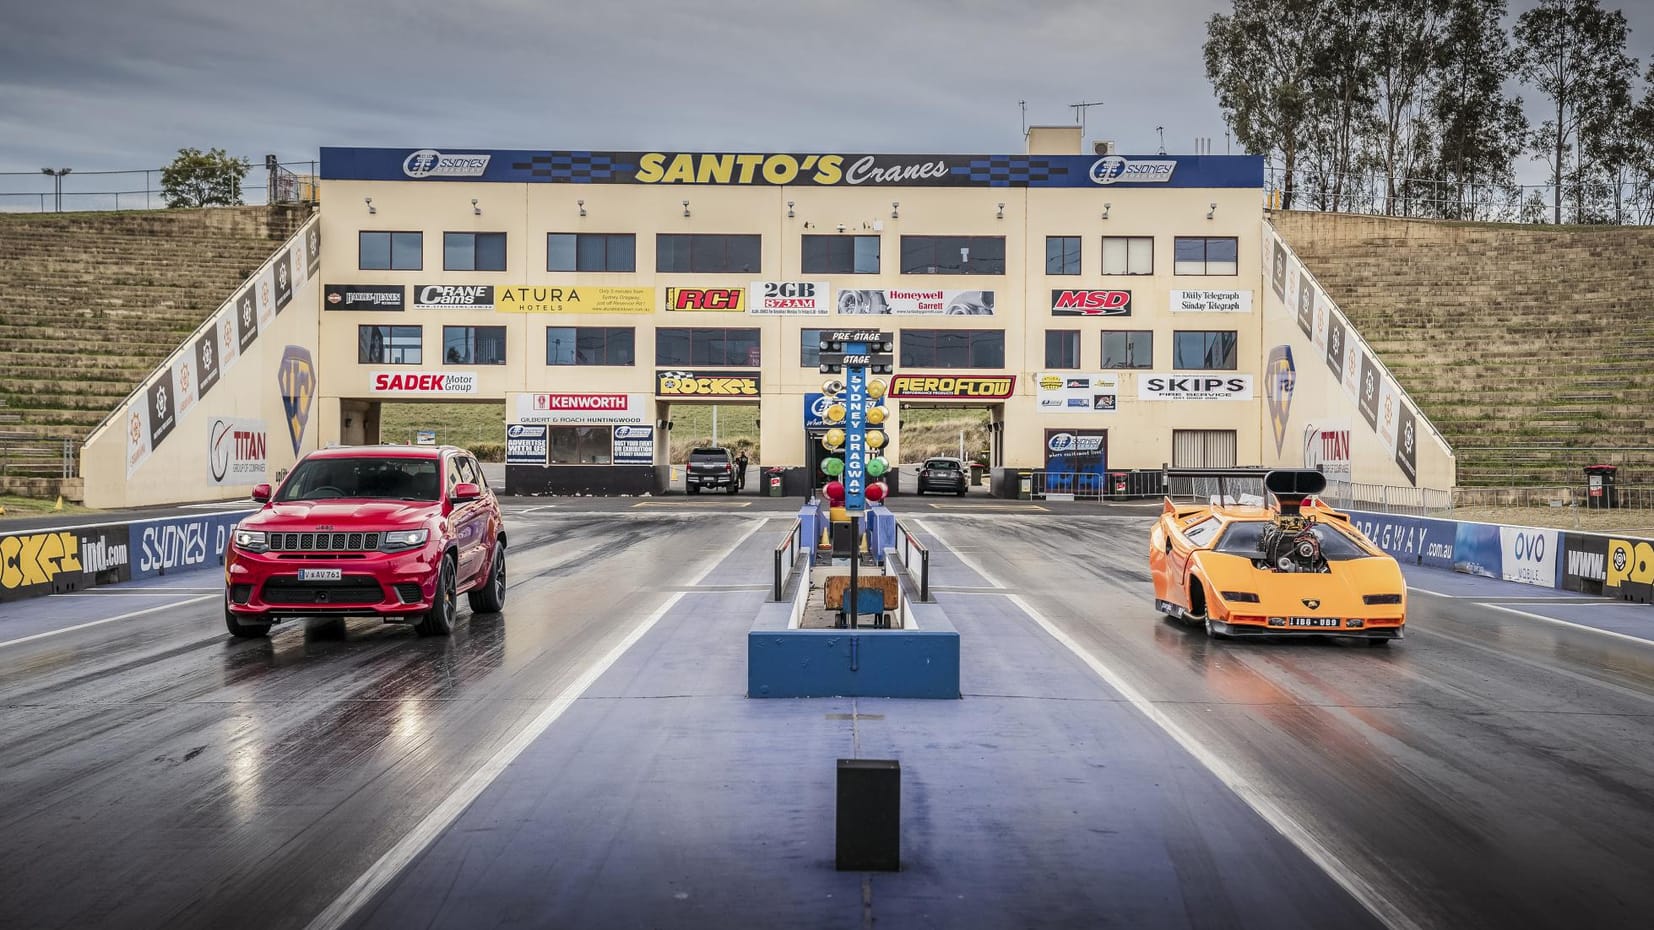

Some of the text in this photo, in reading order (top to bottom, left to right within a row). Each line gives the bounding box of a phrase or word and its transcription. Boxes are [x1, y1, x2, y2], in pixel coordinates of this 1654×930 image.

[635, 153, 949, 185] SANTO'S Cranes
[501, 288, 581, 302] ATURA
[765, 282, 815, 297] 2GB
[890, 290, 943, 301] Honeywell
[1182, 291, 1239, 300] Daily Telegraph
[765, 299, 814, 308] 873AM
[918, 302, 943, 310] Garrett
[1055, 290, 1130, 309] MSD
[1181, 301, 1239, 311] Sunday Telegraph
[375, 374, 472, 390] SADEK Motor
[445, 383, 472, 392] Group
[893, 377, 1012, 396] AEROFLOW
[1147, 378, 1244, 391] SKIPS
[551, 396, 626, 408] KENWORTH
[850, 375, 861, 429] SYDNEY
[234, 431, 266, 460] TITAN
[1321, 430, 1350, 460] TITAN
[847, 434, 862, 496] DRAGWAY
[140, 522, 209, 572] SYDNEY
[1515, 532, 1545, 562] OVO
[0, 532, 128, 589] CKET ind.com
